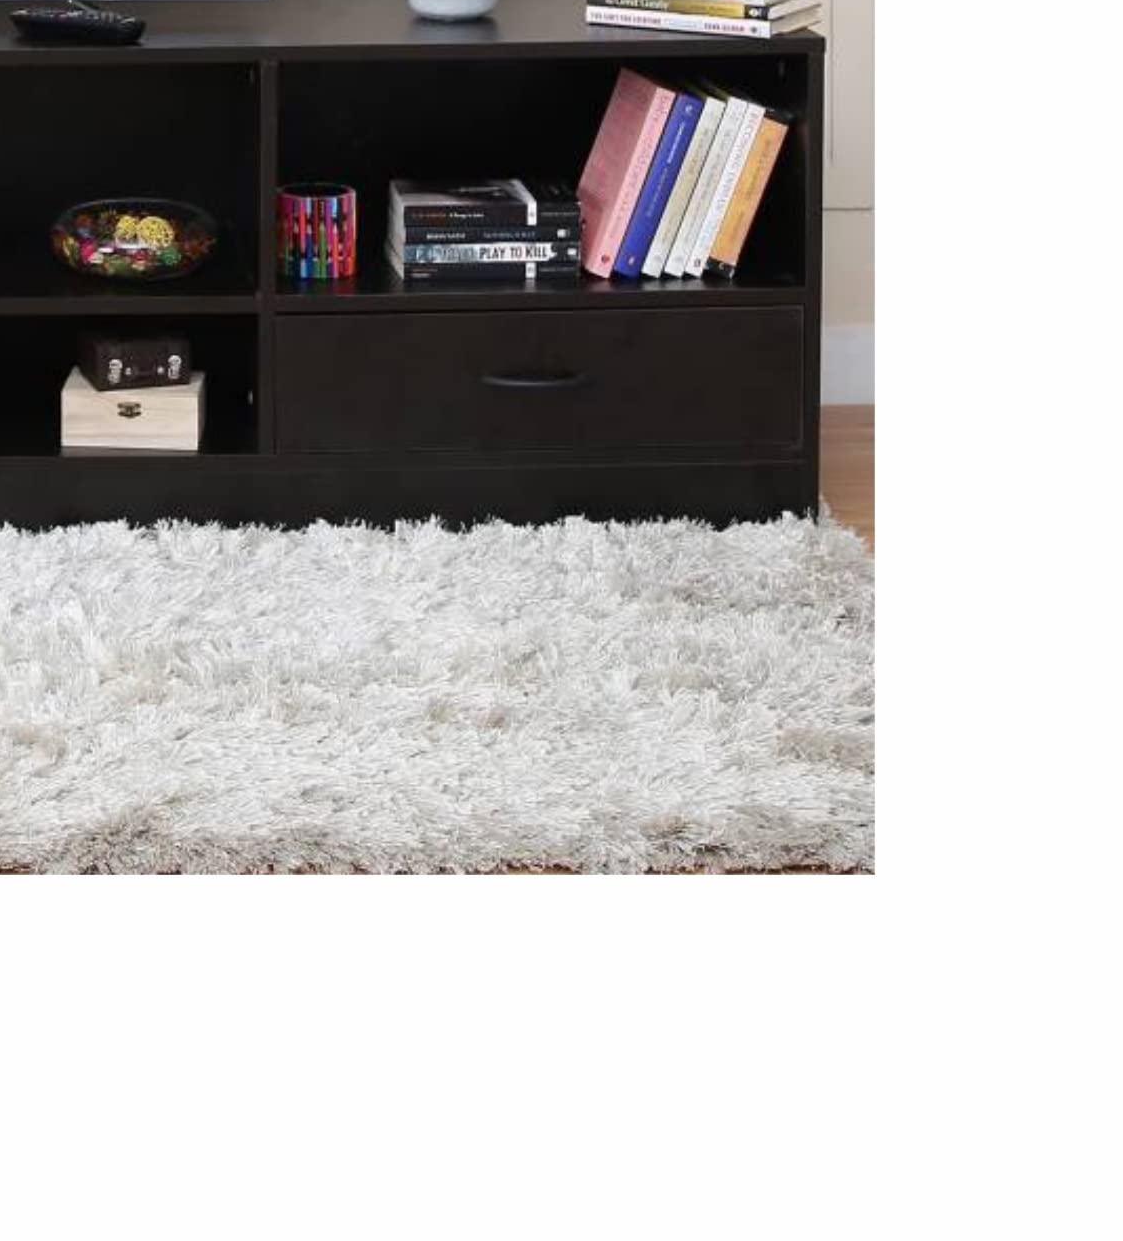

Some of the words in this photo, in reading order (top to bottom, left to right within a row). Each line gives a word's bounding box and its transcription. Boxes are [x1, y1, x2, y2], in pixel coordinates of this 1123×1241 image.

[479, 247, 505, 260] PLAY
[510, 247, 522, 259] TO
[526, 246, 547, 258] KILL
